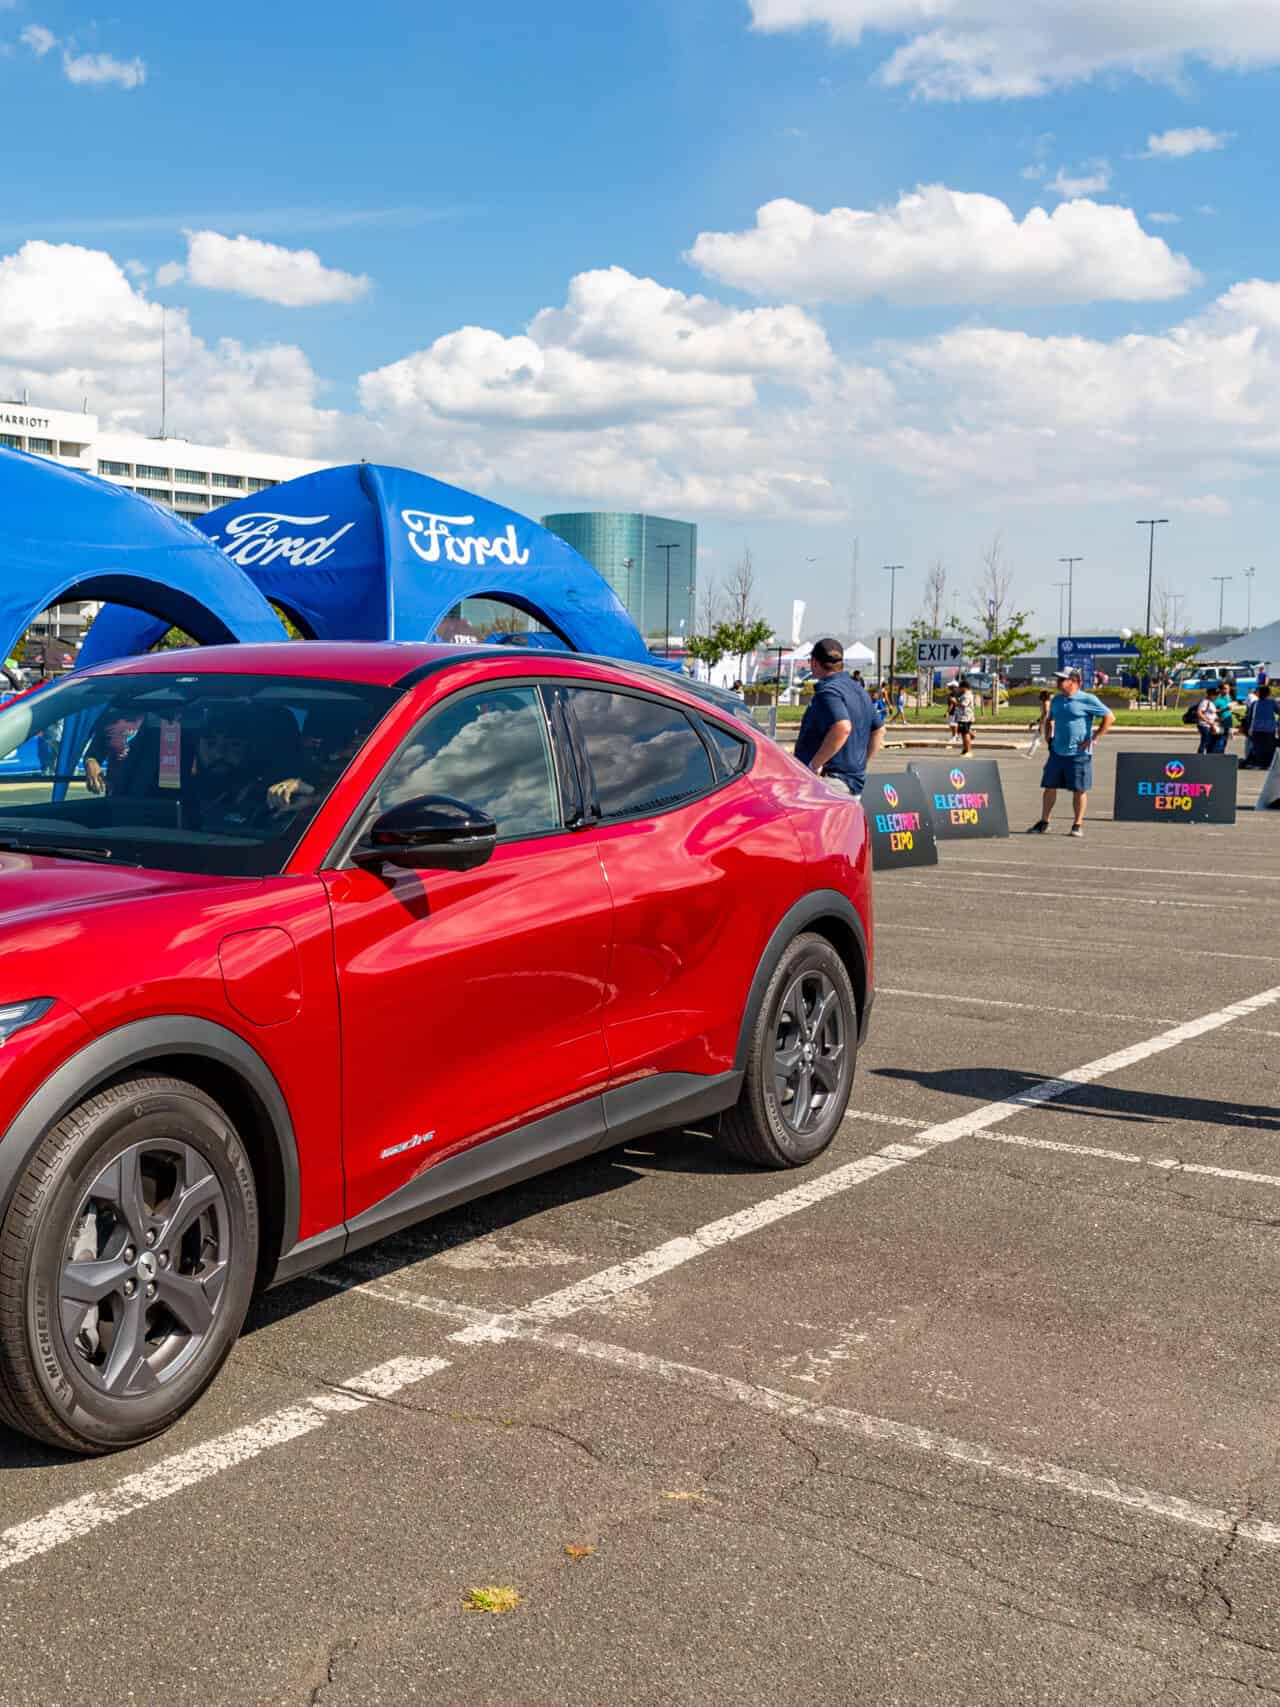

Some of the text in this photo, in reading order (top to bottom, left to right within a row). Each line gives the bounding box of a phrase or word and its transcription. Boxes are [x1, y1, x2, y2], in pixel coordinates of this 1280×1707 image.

[210, 512, 356, 566] Ford
[403, 509, 530, 566] Ford
[918, 643, 950, 660] EXIT
[1137, 781, 1213, 797] ELECTRIFY
[1154, 796, 1193, 811] EXPO
[950, 808, 978, 825] EXPO
[890, 831, 913, 852] EXPO
